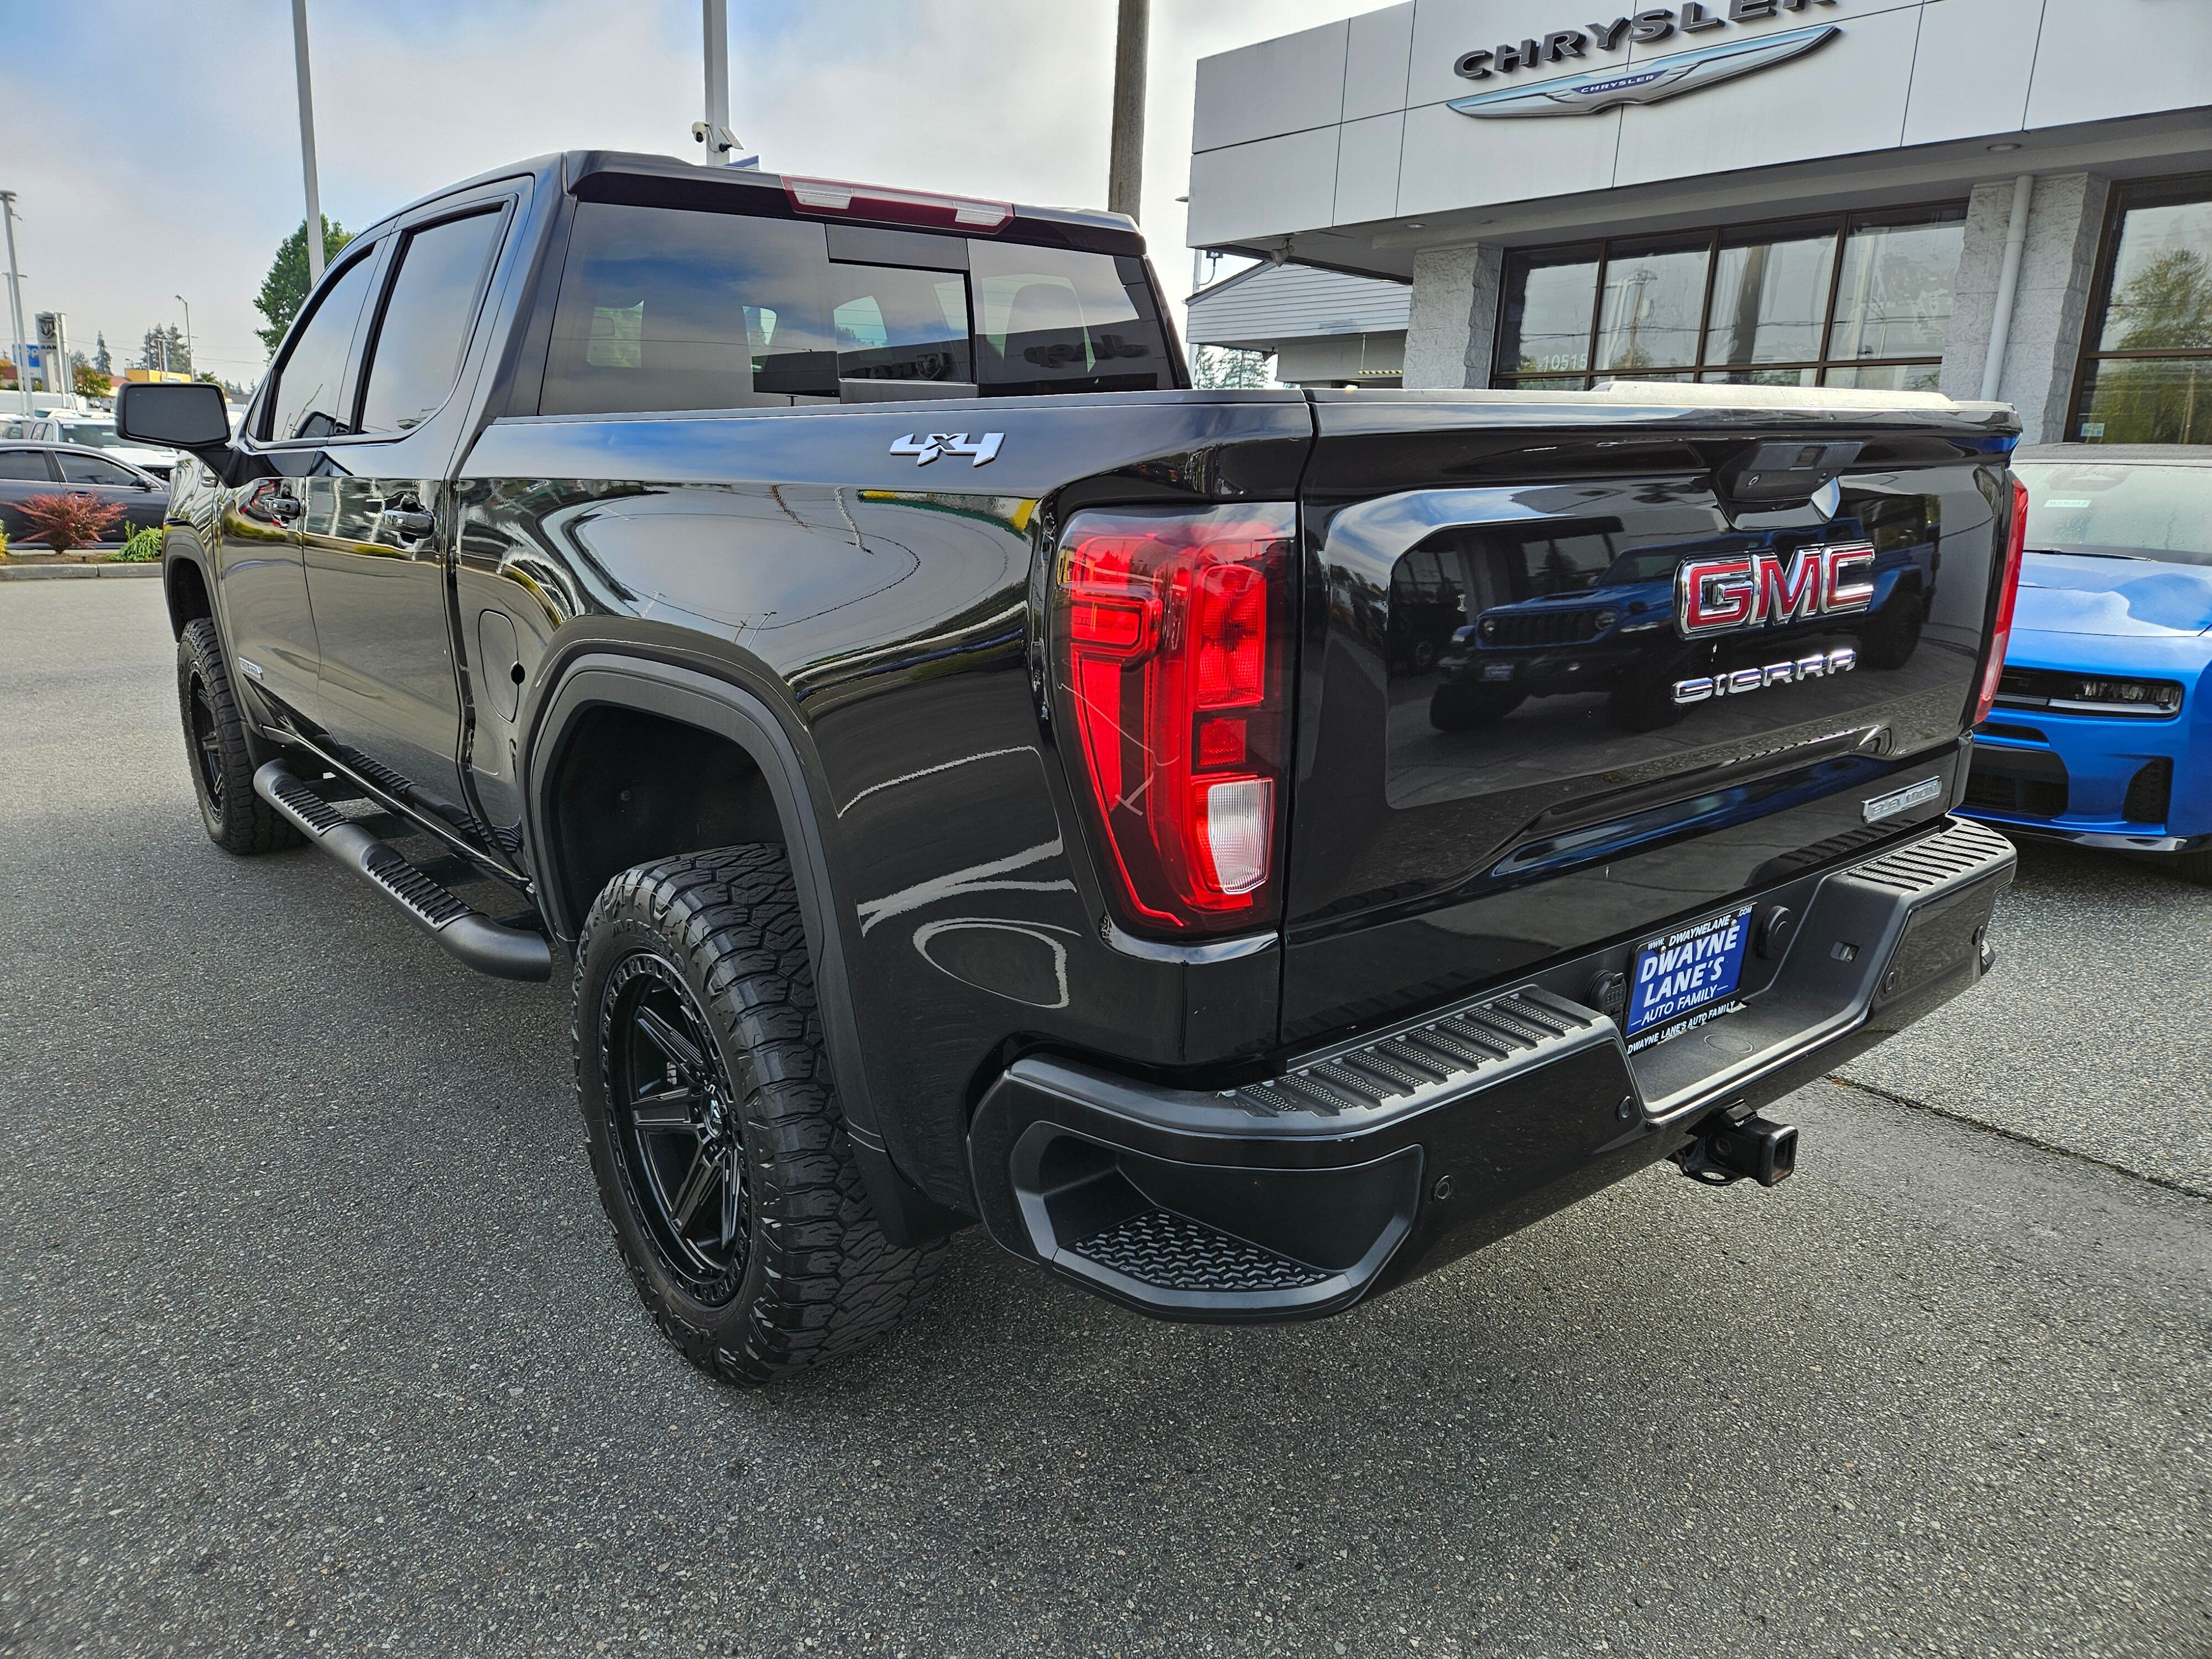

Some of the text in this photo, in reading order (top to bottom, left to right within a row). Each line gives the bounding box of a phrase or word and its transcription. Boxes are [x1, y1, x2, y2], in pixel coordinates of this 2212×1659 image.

[1580, 75, 1655, 93] CHRYSLER
[1542, 353, 1587, 371] 10515
[1679, 541, 1875, 635] GMC
[1672, 649, 1857, 704] SIERRA
[1640, 925, 1740, 984] DWAYNE
[1668, 915, 1731, 947] DWAYNELANE
[1641, 984, 1718, 1026] AUTO FAMILY
[1644, 956, 1725, 1008] LANE'S
[1627, 1000, 1735, 1055] DWAYNE LANE'S AUTO FAMILY
